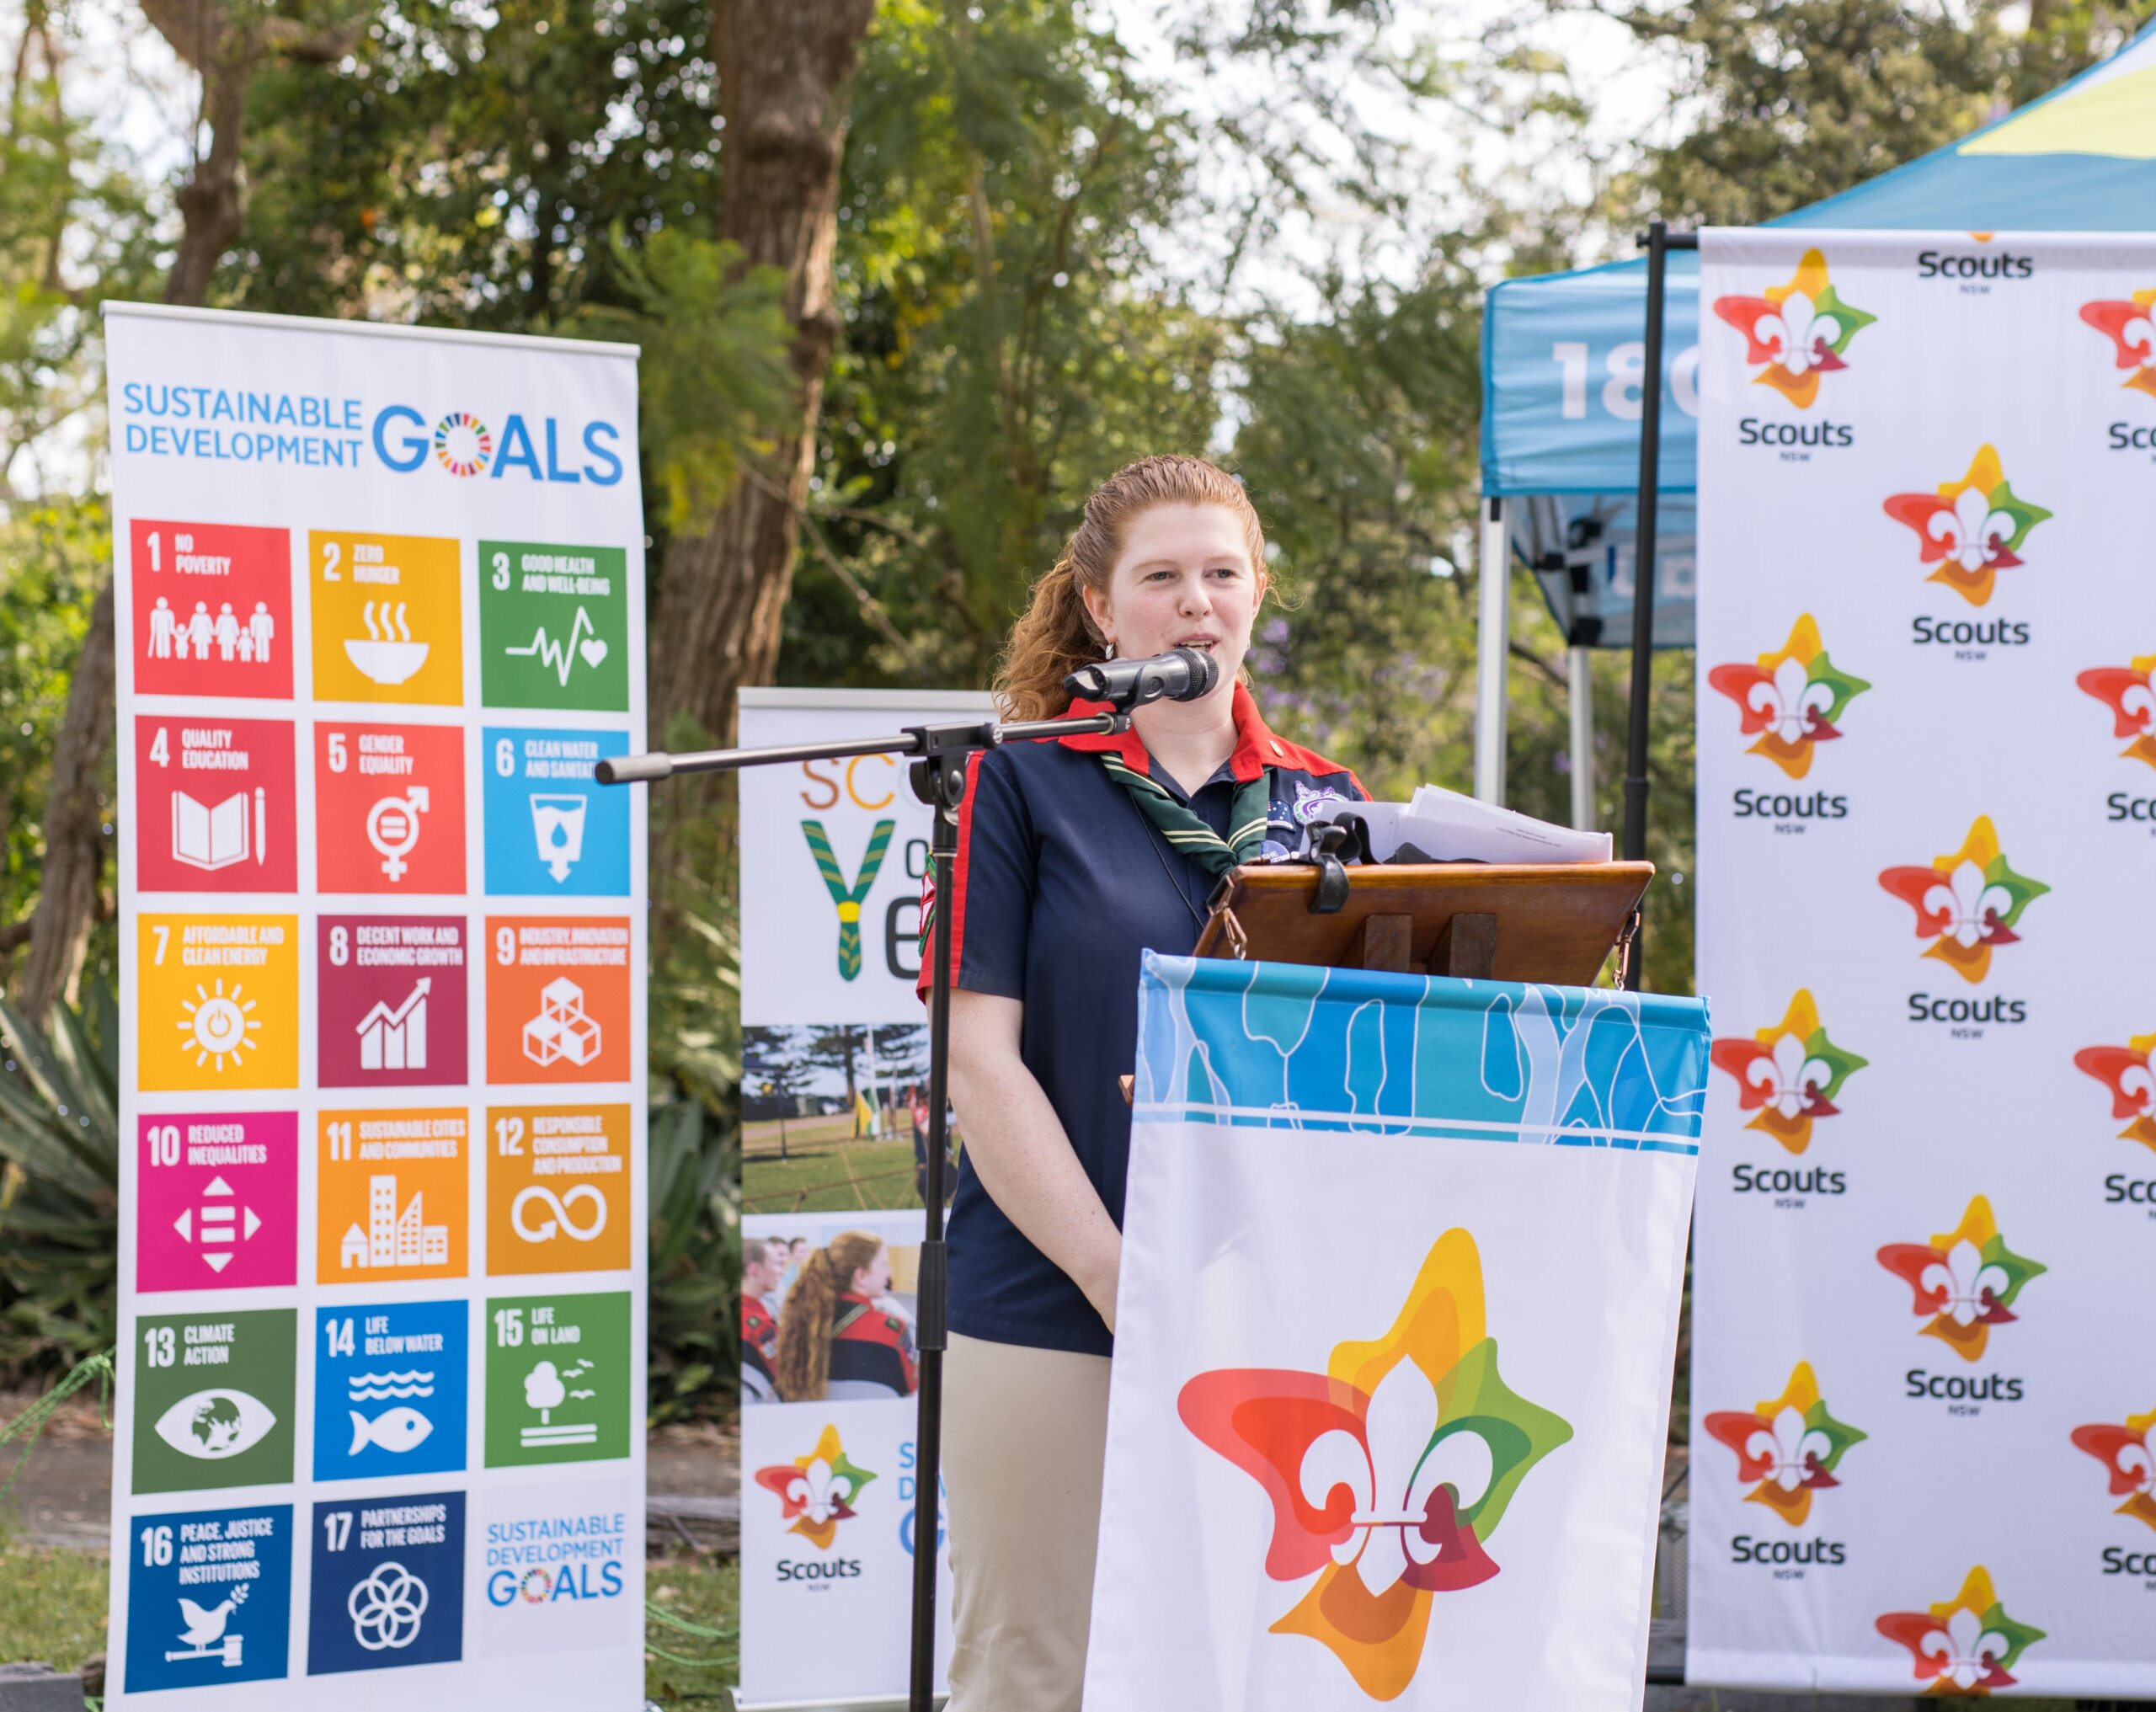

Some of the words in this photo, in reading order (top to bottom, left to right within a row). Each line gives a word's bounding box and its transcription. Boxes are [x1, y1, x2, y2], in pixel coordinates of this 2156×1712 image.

[1918, 251, 2032, 278] Scouts
[1959, 284, 1991, 295] NSW
[124, 382, 363, 431] SUSTAINABLE
[372, 404, 624, 487] GOALS
[1739, 418, 1854, 447] Scouts
[126, 424, 364, 469] DEVELOPMENT
[1779, 451, 1812, 462] NSW
[147, 531, 161, 572] 1
[175, 533, 194, 552] NO
[175, 554, 231, 575] POVERTY
[323, 541, 341, 582] 2
[354, 543, 384, 563] ZERO
[353, 565, 400, 584] HUNGER
[493, 552, 510, 590] 3
[521, 554, 553, 573] GOOD
[553, 556, 595, 575] HEALTH
[522, 573, 547, 593] AND
[547, 575, 611, 596] WELL-BEING
[1913, 616, 2030, 645] Scouts
[1955, 650, 1987, 661] NSW
[149, 727, 170, 768] 4
[182, 728, 232, 749] QUALITY
[182, 749, 248, 771] EDUCATION
[328, 733, 347, 773] 5
[359, 733, 404, 755] GENDER
[495, 738, 515, 777] 6
[525, 739, 561, 758] CLEAN
[561, 741, 599, 760] WATER
[359, 755, 414, 776] EQUALITY
[525, 760, 550, 778] AND
[1733, 789, 1848, 819] Scouts
[1774, 824, 1806, 835] NSW
[152, 925, 170, 966] 7
[183, 925, 258, 945] AFFORDABLE
[259, 925, 285, 945] AND
[183, 947, 221, 966] CLEAN
[222, 947, 268, 966] ENERGY
[329, 925, 349, 967] 8
[356, 925, 400, 946] DECENT
[400, 925, 435, 946] WORK
[435, 926, 459, 946] AND
[356, 947, 416, 966] ECONOMIC
[416, 947, 463, 966] GROWTH
[497, 926, 515, 966] 9
[572, 926, 628, 946] INNOVATION
[520, 947, 544, 966] AND
[544, 947, 627, 966] INFRASTRUCTURE
[1908, 993, 2026, 1023] Scouts
[1951, 1028, 1984, 1040] NSW
[147, 1125, 180, 1166] 10
[188, 1124, 244, 1144] REDUCED
[327, 1121, 351, 1160] 11
[360, 1120, 431, 1139] SUSTAINABLE
[432, 1118, 466, 1137] CITIES
[495, 1117, 524, 1156] 12
[533, 1115, 603, 1134] RESPONSIBLE
[533, 1135, 608, 1155] CONSUMPTION
[188, 1144, 267, 1166] INEQUALITIES
[360, 1141, 384, 1160] AND
[385, 1139, 458, 1160] COMMUNITIES
[532, 1156, 557, 1175] AND
[557, 1155, 622, 1175] PRODUCTION
[1732, 1164, 1846, 1195] Scouts
[1774, 1197, 1806, 1209] NSW
[325, 1317, 355, 1357] 14
[365, 1315, 389, 1335] LIFE
[494, 1308, 522, 1347] 15
[531, 1306, 554, 1325] LIFE
[531, 1327, 548, 1346] ON
[550, 1325, 581, 1345] LAND
[144, 1326, 175, 1368] 13
[184, 1323, 235, 1344] CLIMATE
[184, 1345, 229, 1366] ACTION
[365, 1336, 405, 1356] BELOW
[405, 1333, 444, 1352] WATER
[1906, 1369, 2024, 1401] Scouts
[1947, 1404, 1982, 1416] NSW
[324, 1511, 354, 1552] 17
[361, 1503, 446, 1528] PARTNERSHIPS
[360, 1529, 385, 1549] FOR
[385, 1528, 406, 1548] THE
[406, 1523, 446, 1545] GOALS
[488, 1513, 625, 1544] SUSTAINABLE
[141, 1525, 173, 1567] 16
[180, 1522, 224, 1543] PEACE,
[224, 1517, 274, 1539] JUSTICE
[179, 1544, 207, 1564] AND
[207, 1539, 255, 1562] STRONG
[487, 1538, 624, 1566] DEVELOPMENT
[1732, 1535, 1846, 1565] Scouts
[179, 1560, 260, 1585] INSTITUTIONS
[776, 1556, 862, 1581] Scouts
[1773, 1569, 1806, 1580] NSW
[487, 1560, 623, 1607] GOALS
